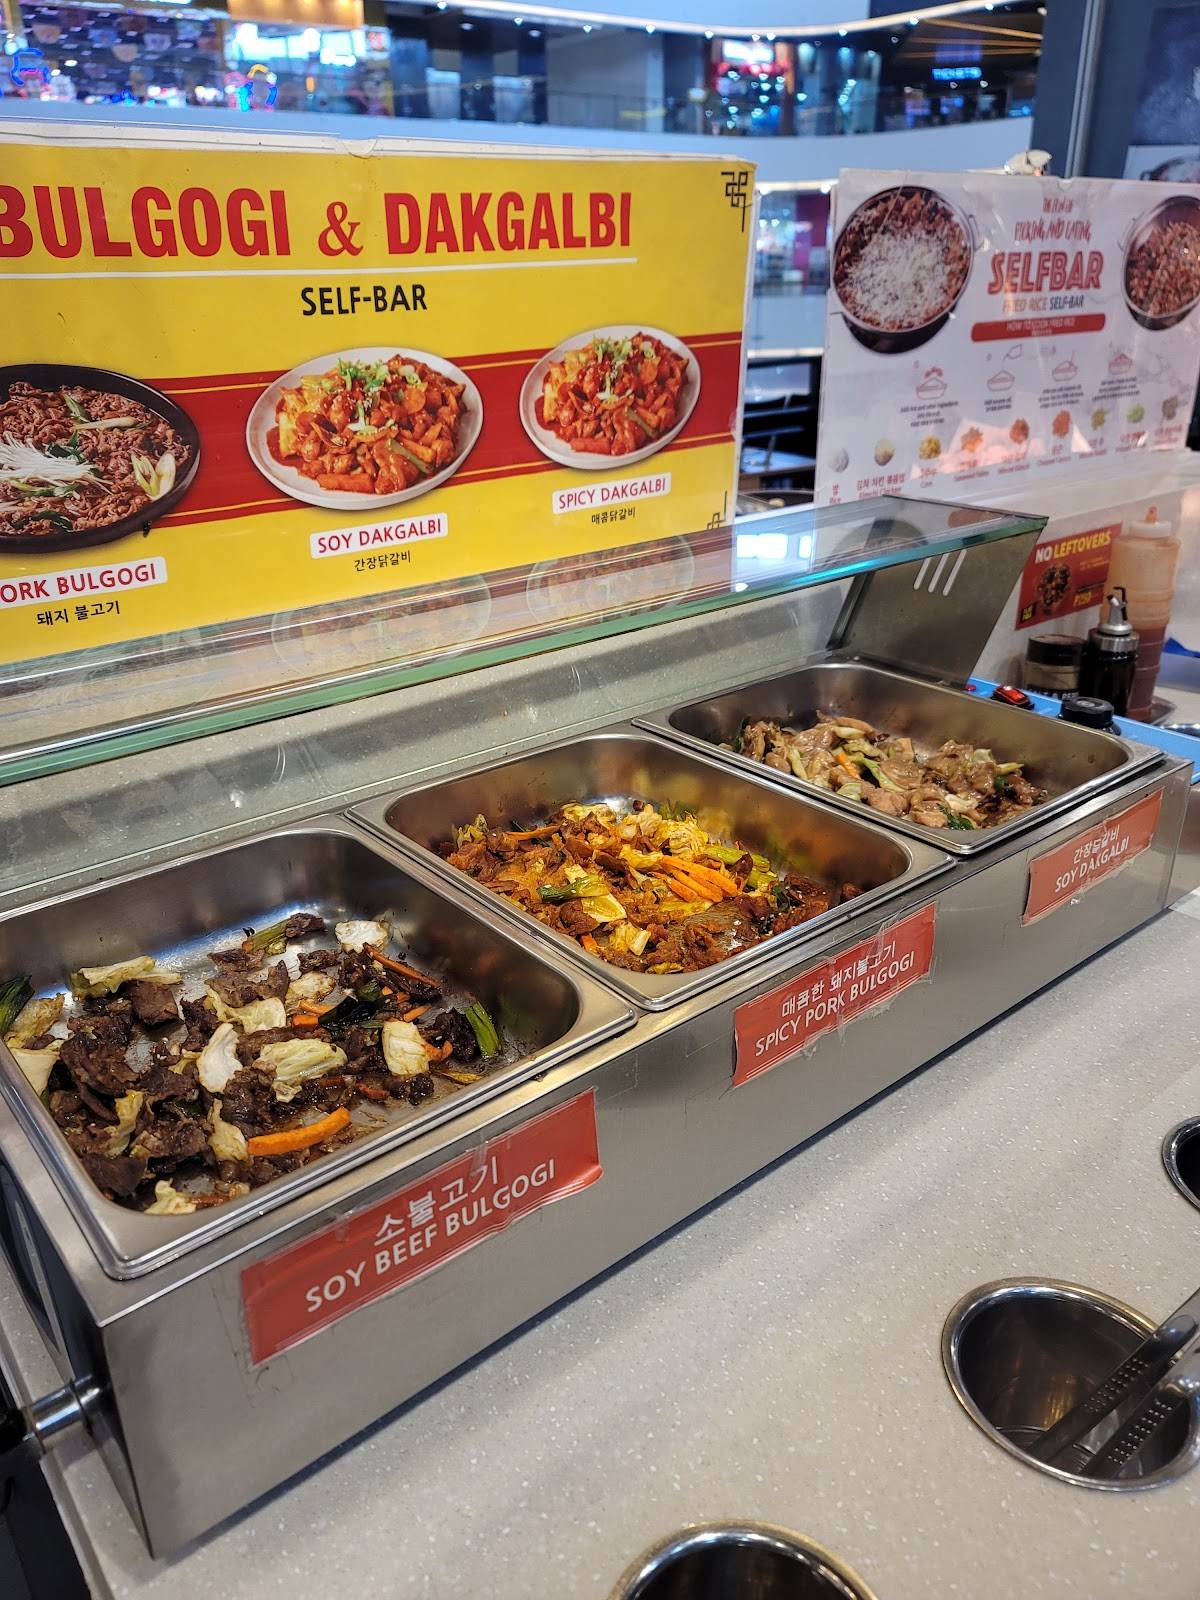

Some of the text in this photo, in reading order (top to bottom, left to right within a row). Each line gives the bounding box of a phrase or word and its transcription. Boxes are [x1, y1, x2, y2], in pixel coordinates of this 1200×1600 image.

[0, 185, 632, 258] BULGOGI & DAKGALBI
[988, 252, 1104, 295] SELFBAR
[300, 284, 428, 316] SELF-BAR
[559, 477, 666, 509] SPICY DAKGALBI
[318, 518, 441, 554] SOY DAKGALBI
[1035, 531, 1112, 563] NO LEFTOVERS
[354, 550, 411, 572] 간장닭갈비
[0, 563, 156, 603] ORK BULGOGI
[37, 600, 121, 626] 돼지 불고기
[1055, 867, 1079, 893] SOY
[781, 941, 896, 1017] 매콤한 돼지불고기
[755, 951, 914, 1057] SPICY PORK BULGOGI
[373, 1156, 499, 1246] 소불고기
[305, 1159, 556, 1313] SOY BEEF BULGOGI
